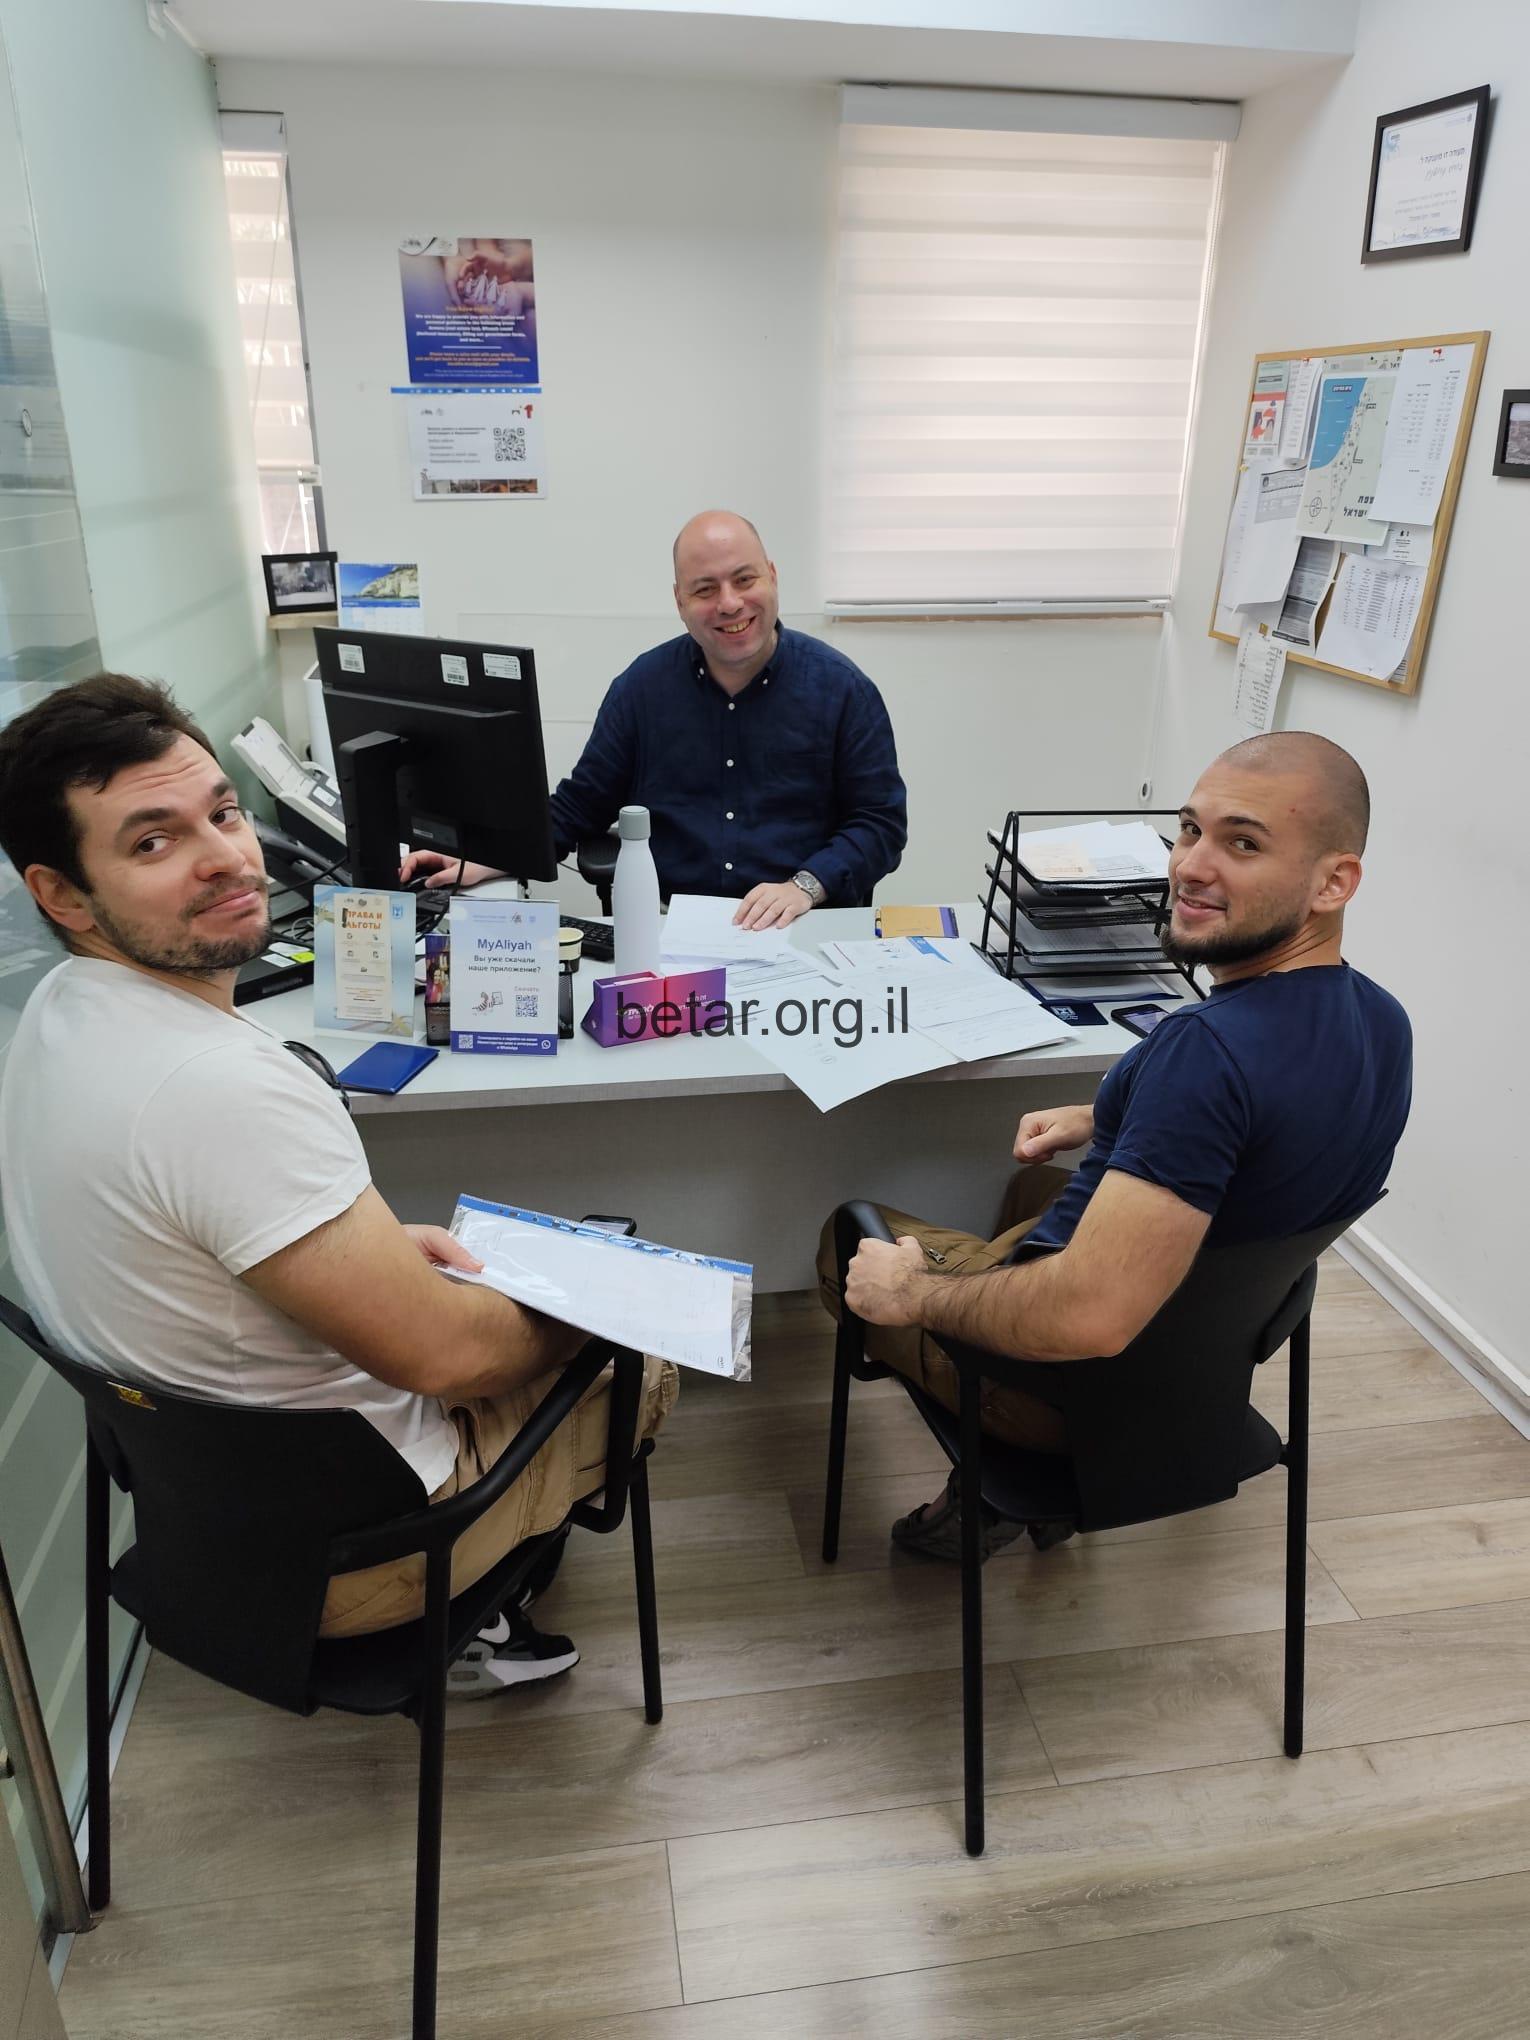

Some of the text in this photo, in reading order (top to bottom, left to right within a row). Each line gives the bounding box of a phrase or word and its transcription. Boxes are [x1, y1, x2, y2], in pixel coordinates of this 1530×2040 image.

[1343, 506, 1368, 517] ישראל
[477, 939, 532, 952] MyAliyah
[490, 966, 541, 974] приложение?
